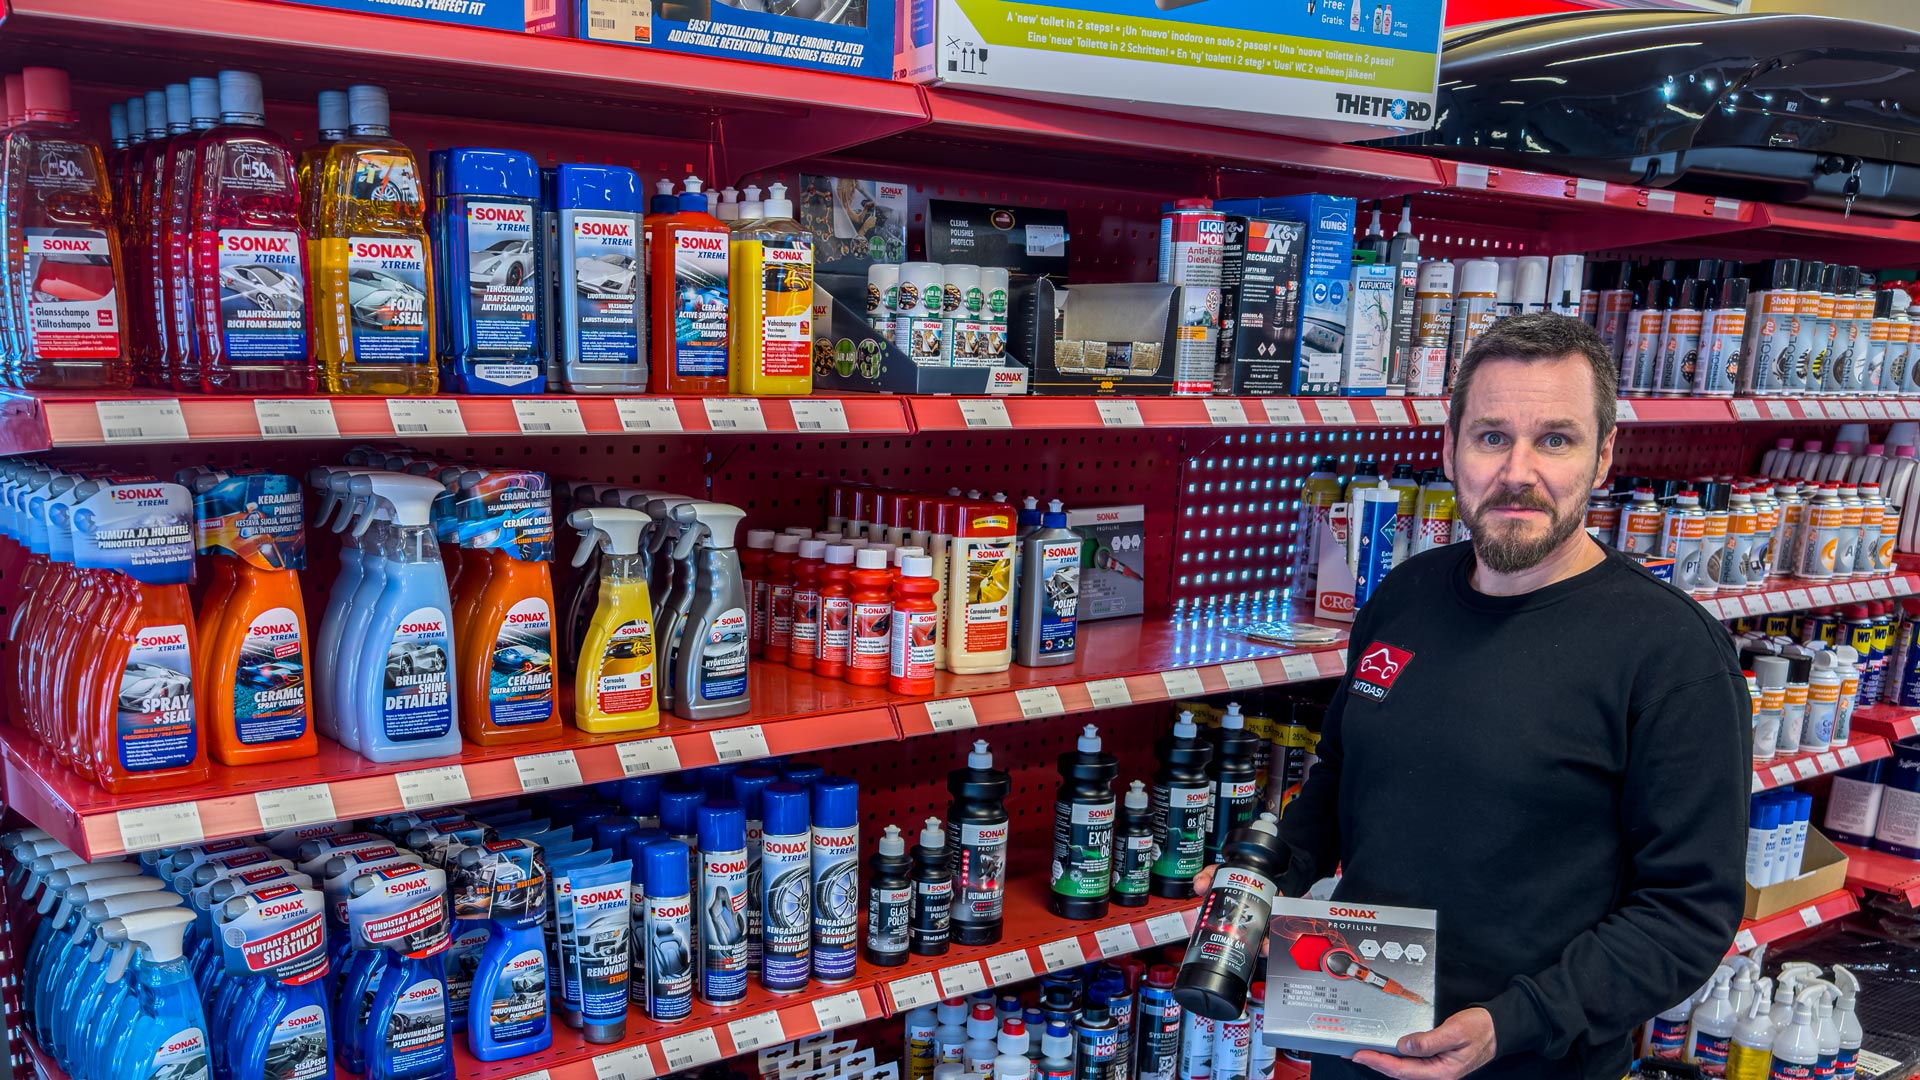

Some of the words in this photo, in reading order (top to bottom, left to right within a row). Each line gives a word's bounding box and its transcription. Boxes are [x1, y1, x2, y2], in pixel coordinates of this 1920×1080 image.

[469, 2, 485, 16] FIT
[1321, 14, 1345, 26] Gratis:
[687, 19, 710, 33] EASY
[710, 20, 770, 41] INSTALLATION,
[772, 31, 800, 46] TRIPLE
[800, 35, 833, 51] CHROME
[833, 40, 864, 55] PLATED
[1007, 12, 1013, 22] A
[1014, 13, 1039, 25] 'new'
[1040, 15, 1065, 28] toilet
[1067, 18, 1076, 29] in
[1077, 20, 1083, 30] 2
[1085, 21, 1114, 34] steps!
[1122, 25, 1138, 37] ¡Un
[1139, 26, 1170, 40] 'nuevo'
[1171, 30, 1203, 45] inodoro
[1205, 36, 1216, 46] en
[1217, 36, 1235, 48] solo
[1236, 38, 1242, 48] 2
[1243, 39, 1272, 53] pasos!
[1279, 43, 1295, 55] Una
[1325, 48, 1353, 62] toilette
[1355, 51, 1363, 63] in
[1364, 53, 1370, 64] 2
[1370, 55, 1395, 68] passi!
[667, 30, 719, 48] ADJUSTABLE
[718, 37, 765, 55] RETENTION
[765, 42, 782, 57] RING
[782, 44, 819, 62] ASSURES
[819, 49, 850, 66] PERFECT
[850, 56, 864, 68] FIT
[1027, 31, 1048, 44] Eine
[1049, 33, 1076, 47] 'neue'
[1077, 35, 1109, 51] Toilette
[1109, 39, 1119, 51] in
[1120, 42, 1126, 52] 2
[1127, 42, 1169, 57] Schritten!
[1176, 47, 1188, 59] En
[1205, 51, 1232, 64] toalett
[1237, 55, 1243, 66] 2
[1244, 57, 1265, 71] steg!
[1295, 61, 1307, 73] WC
[1308, 63, 1314, 74] 2
[1315, 64, 1344, 78] vaiheen
[1345, 67, 1376, 82] jälkeen!
[1335, 92, 1432, 122] THETFORD
[879, 185, 903, 196] SONAX
[475, 207, 525, 222] SONAX
[496, 222, 530, 233] XTREME
[581, 222, 629, 237] SONAX
[949, 218, 969, 229] CLEANS
[1320, 219, 1347, 232] KUNGS
[949, 228, 974, 238] POLISHES
[1200, 233, 1224, 246] MOLY
[43, 238, 92, 252] SONAX
[227, 236, 290, 253] SONAX
[601, 236, 633, 247] XTREME
[681, 236, 723, 251] SONAX
[949, 237, 975, 248] PROTECTS
[357, 243, 415, 259] SONAX
[697, 251, 726, 260] XTREME
[772, 250, 803, 262] SONAX
[254, 253, 296, 265] XTREME
[381, 259, 421, 271] XTREME
[1246, 253, 1285, 264] RECHARGER
[486, 285, 534, 294] TEHOSHAMPOO
[1359, 281, 1393, 290] AVFUKTARE
[483, 294, 534, 303] KRAFTSCHAMPO
[390, 298, 423, 313] FOAM
[701, 303, 727, 312] CERAMIC
[35, 307, 90, 319] Glansschampo
[236, 309, 301, 319] VAAHTOSHAMPOO
[391, 312, 424, 326] +SEAL
[678, 311, 698, 319] ACTIVE
[698, 312, 727, 320] SHAMPOO
[37, 319, 91, 331] Kiiltoshampoo
[227, 319, 246, 329] RICH
[246, 320, 266, 329] FOAM
[266, 320, 302, 330] SHAMPOO
[700, 330, 727, 338] SHAMPOO
[994, 372, 1022, 382] SONAX
[117, 487, 164, 500] SONAX
[500, 490, 530, 501] CERAMIC
[137, 499, 169, 507] XTREME
[503, 517, 533, 528] CERAMIC
[1096, 512, 1119, 521] SONAX
[95, 528, 135, 541] SUMUTA
[136, 527, 150, 538] JA
[150, 524, 189, 538] HUUHTELE
[98, 538, 146, 550] PINNOITETTU
[146, 536, 166, 546] AUTO
[977, 549, 1004, 559] SONAX
[1047, 546, 1077, 558] SONAX
[1053, 597, 1078, 610] POLISH
[1321, 595, 1354, 611] CRC
[509, 611, 546, 624] SONAX
[863, 607, 888, 615] SONAX
[402, 621, 441, 634] SONAX
[523, 620, 549, 629] XTREME
[721, 616, 744, 626] SONAX
[253, 623, 294, 636] SONAX
[417, 630, 445, 640] XTREME
[622, 626, 646, 636] SONAX
[141, 634, 182, 647] SONAX
[269, 632, 299, 642] XTREME
[158, 643, 187, 652] XTREME
[395, 671, 447, 687] BRILLIANT
[507, 672, 552, 686] CERAMIC
[418, 682, 447, 694] SHINE
[254, 686, 304, 704] CERAMIC
[385, 691, 448, 711] DETAILER
[142, 694, 190, 714] SPRAY
[257, 701, 277, 710] SPRAY
[278, 698, 304, 708] COATING
[153, 709, 191, 726] +SEAL
[1088, 807, 1113, 819] SONAX
[300, 823, 335, 839] SONAX
[979, 828, 1006, 839] SONAX
[814, 833, 855, 848] SONAX
[1088, 831, 1101, 846] EX
[1101, 830, 1111, 844] 04
[765, 841, 807, 855] SONAX
[829, 845, 858, 855] XTREME
[781, 852, 809, 863] XTREME
[390, 878, 428, 894] SONAX
[1228, 872, 1264, 891] SONAX
[406, 885, 432, 898] XTREME
[580, 888, 623, 905] SONAX
[968, 890, 992, 900] ULTIMATE
[1223, 887, 1261, 904] PROFILINE
[264, 899, 304, 918] SONAX
[597, 899, 628, 911] XTREME
[281, 907, 309, 921] XTREME
[367, 914, 409, 934] PUHDISTAA
[409, 911, 418, 922] JA
[418, 900, 442, 921] SUOJAA
[1329, 906, 1378, 920] SONAX
[372, 922, 407, 940] MUOVIOSAT
[407, 917, 423, 931] AUTON
[423, 909, 443, 926] SISÄLLÄ
[1327, 921, 1378, 933] PROFILINE
[245, 938, 284, 956] PUHTAAT
[282, 934, 290, 946] &
[290, 918, 322, 941] RAIKKAAT
[461, 935, 487, 947] SONAX
[1209, 933, 1236, 948] CUTMAX
[263, 932, 318, 965] SISÄTILAT
[513, 956, 540, 969] SONAX
[409, 987, 438, 1000] SONAX
[287, 1012, 319, 1028] SONAX
[392, 1023, 444, 1041] MUOVINKIRKASTE
[167, 1036, 199, 1053] SONAX
